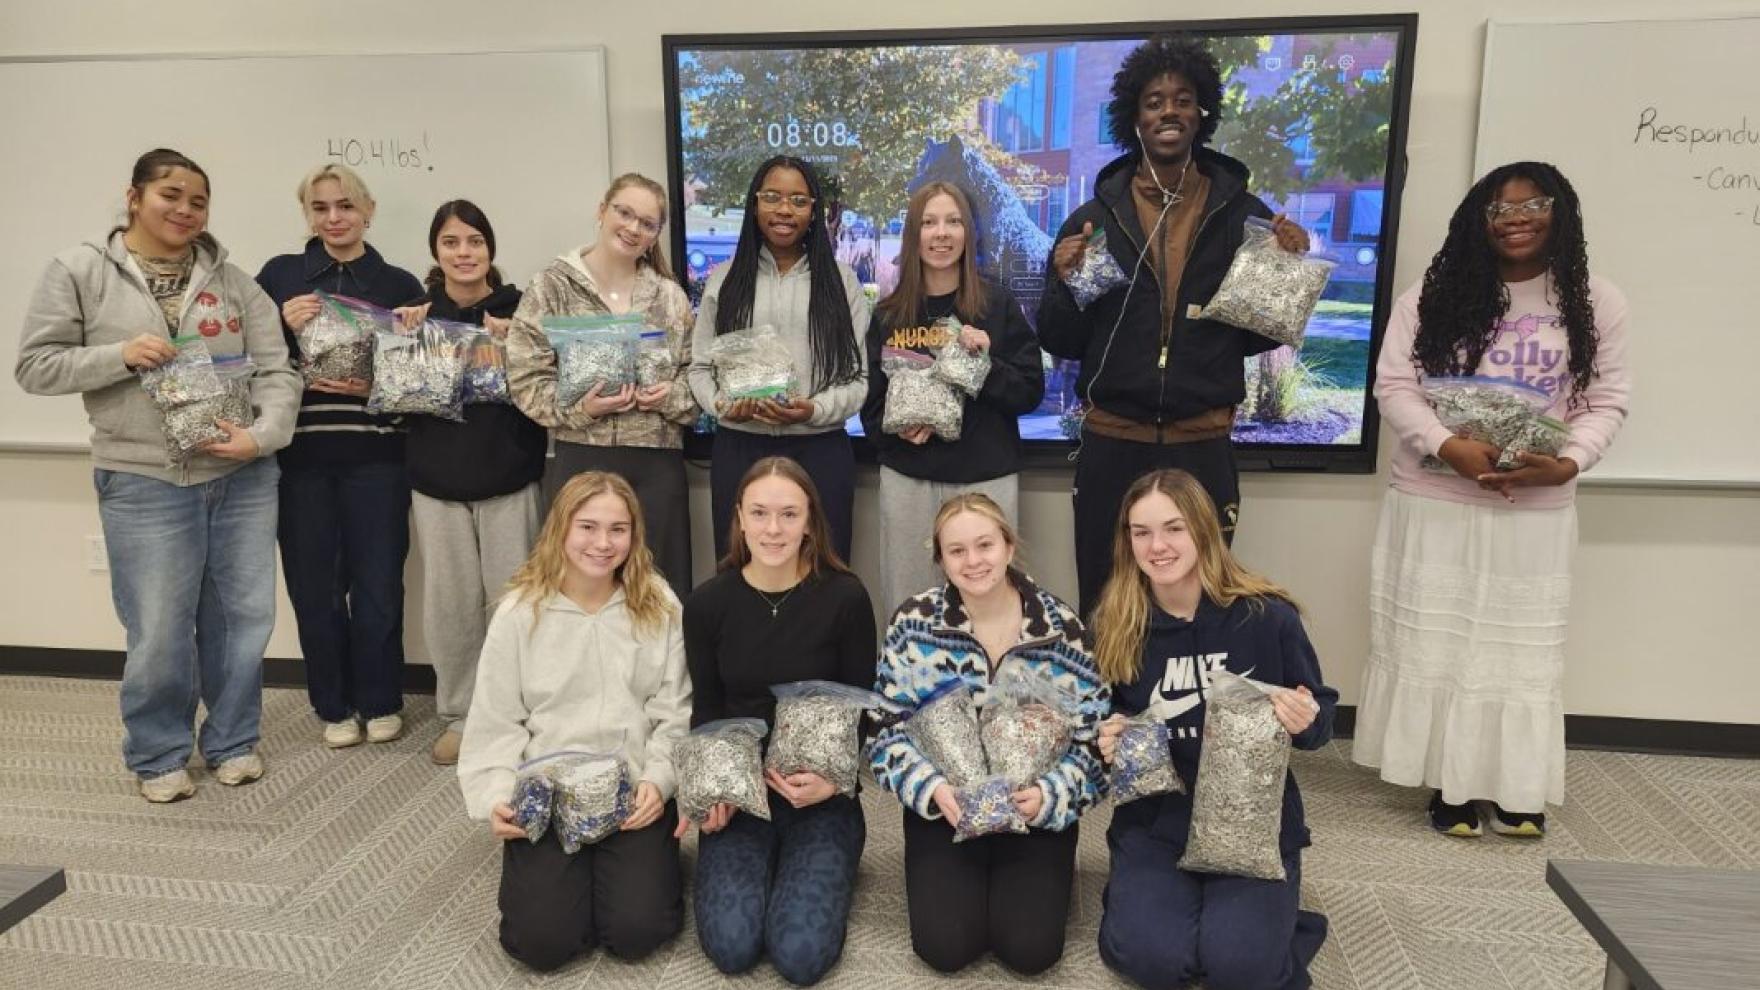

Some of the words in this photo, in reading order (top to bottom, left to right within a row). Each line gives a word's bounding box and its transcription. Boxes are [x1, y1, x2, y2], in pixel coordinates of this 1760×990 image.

[767, 121, 847, 148] 08:08
[1488, 341, 1563, 373] olly
[1162, 652, 1228, 692] NIKE
